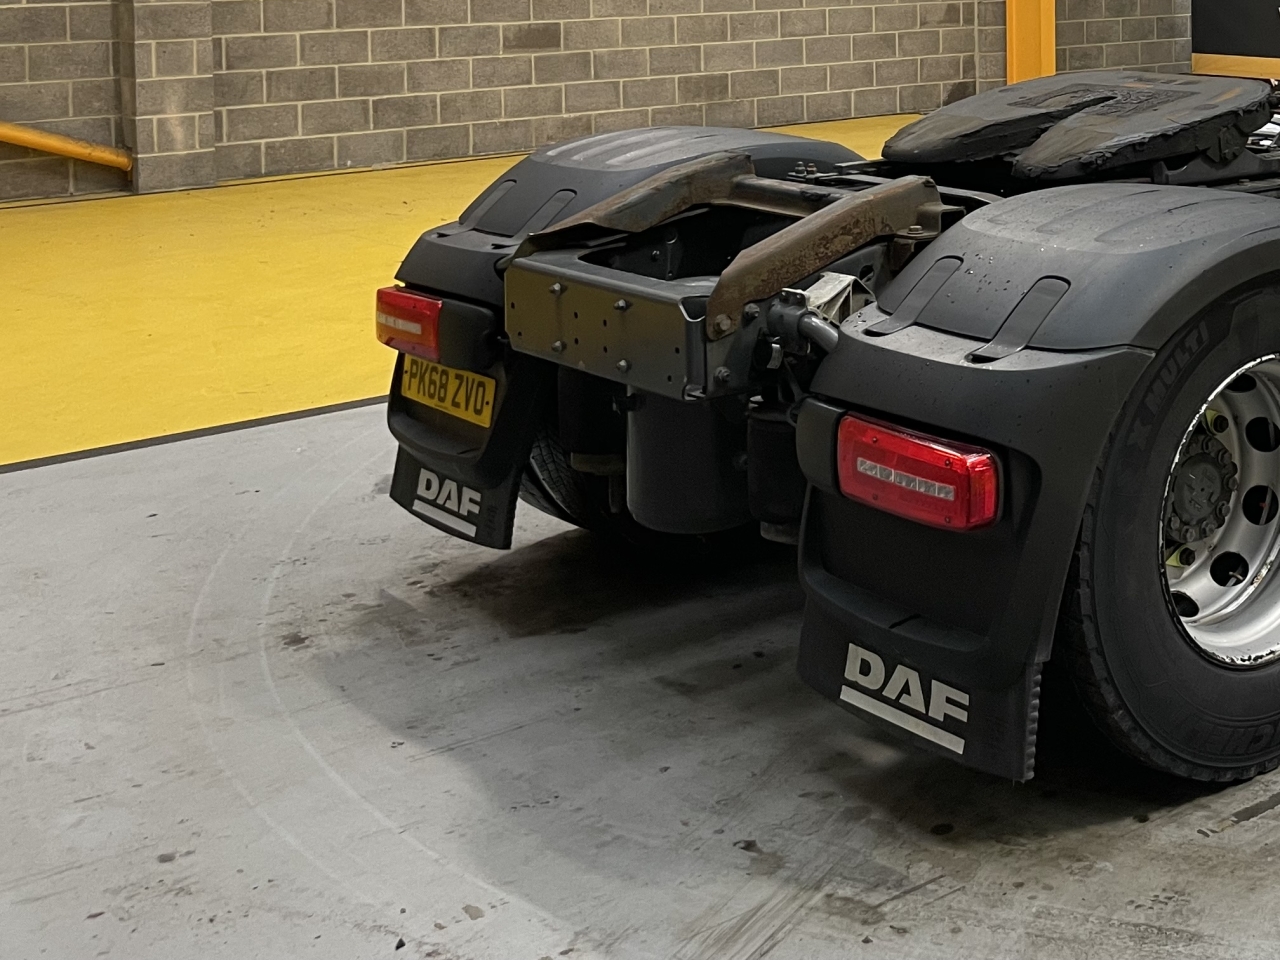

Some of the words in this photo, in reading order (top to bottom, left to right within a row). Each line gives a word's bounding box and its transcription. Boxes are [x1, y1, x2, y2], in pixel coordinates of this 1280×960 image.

[407, 358, 450, 403] PK68
[416, 467, 482, 516] DAF
[843, 642, 971, 723] DAF
